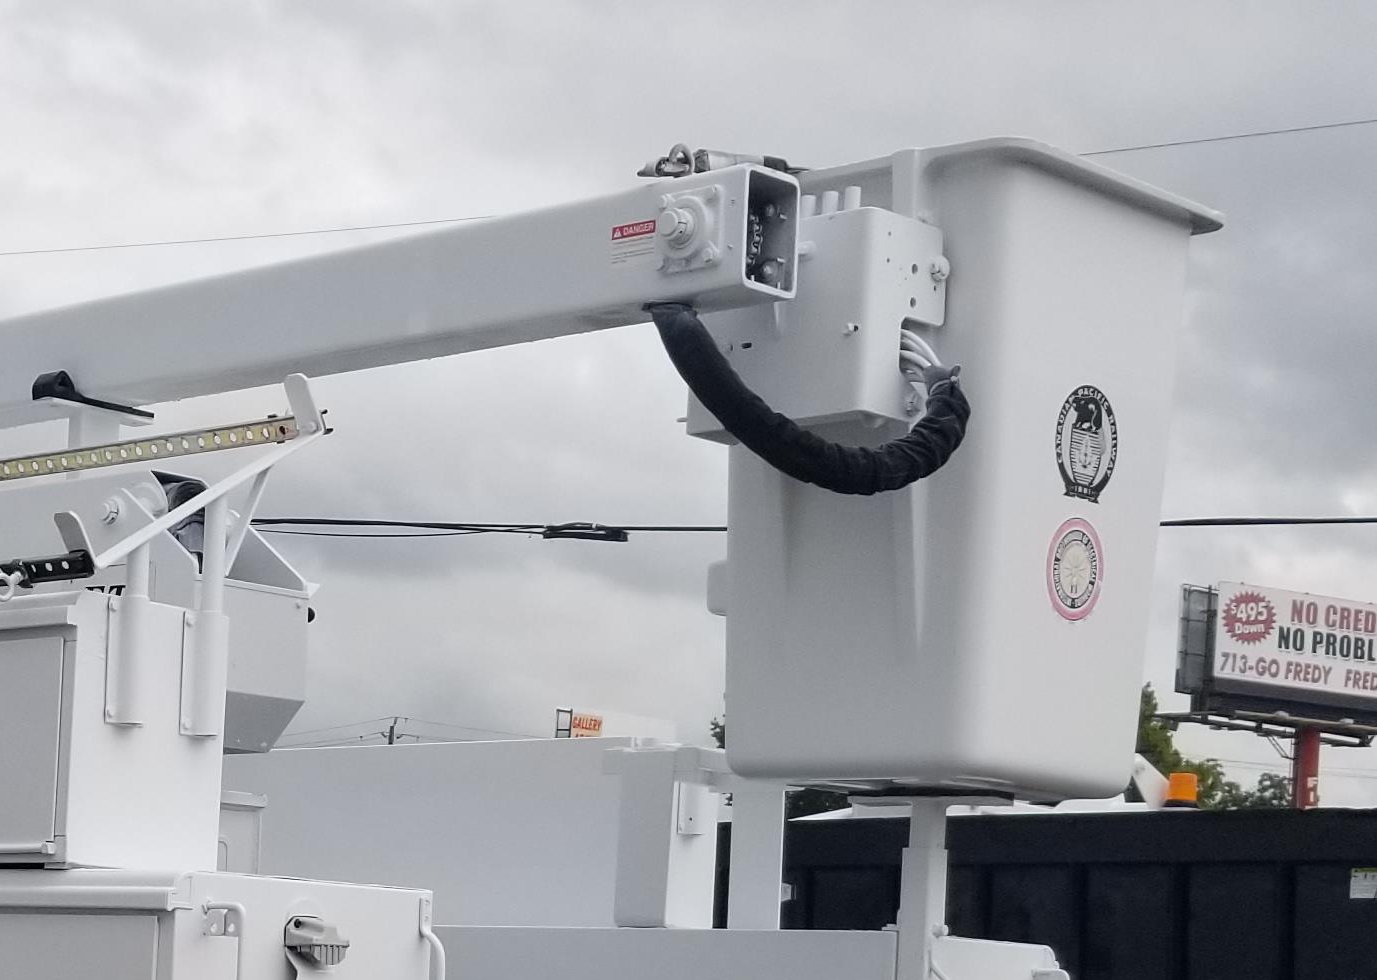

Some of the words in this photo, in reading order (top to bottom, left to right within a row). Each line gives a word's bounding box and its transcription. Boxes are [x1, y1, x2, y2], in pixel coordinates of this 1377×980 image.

[1231, 602, 1267, 622] $495
[1291, 599, 1318, 626] NO
[1324, 604, 1377, 634] CRED
[1235, 623, 1265, 634] Down
[1278, 625, 1305, 652] NO
[1311, 630, 1377, 662] PROBL
[1220, 651, 1280, 678] 713-GO
[1284, 660, 1332, 685] FREDY
[573, 716, 602, 731] GALLERY
